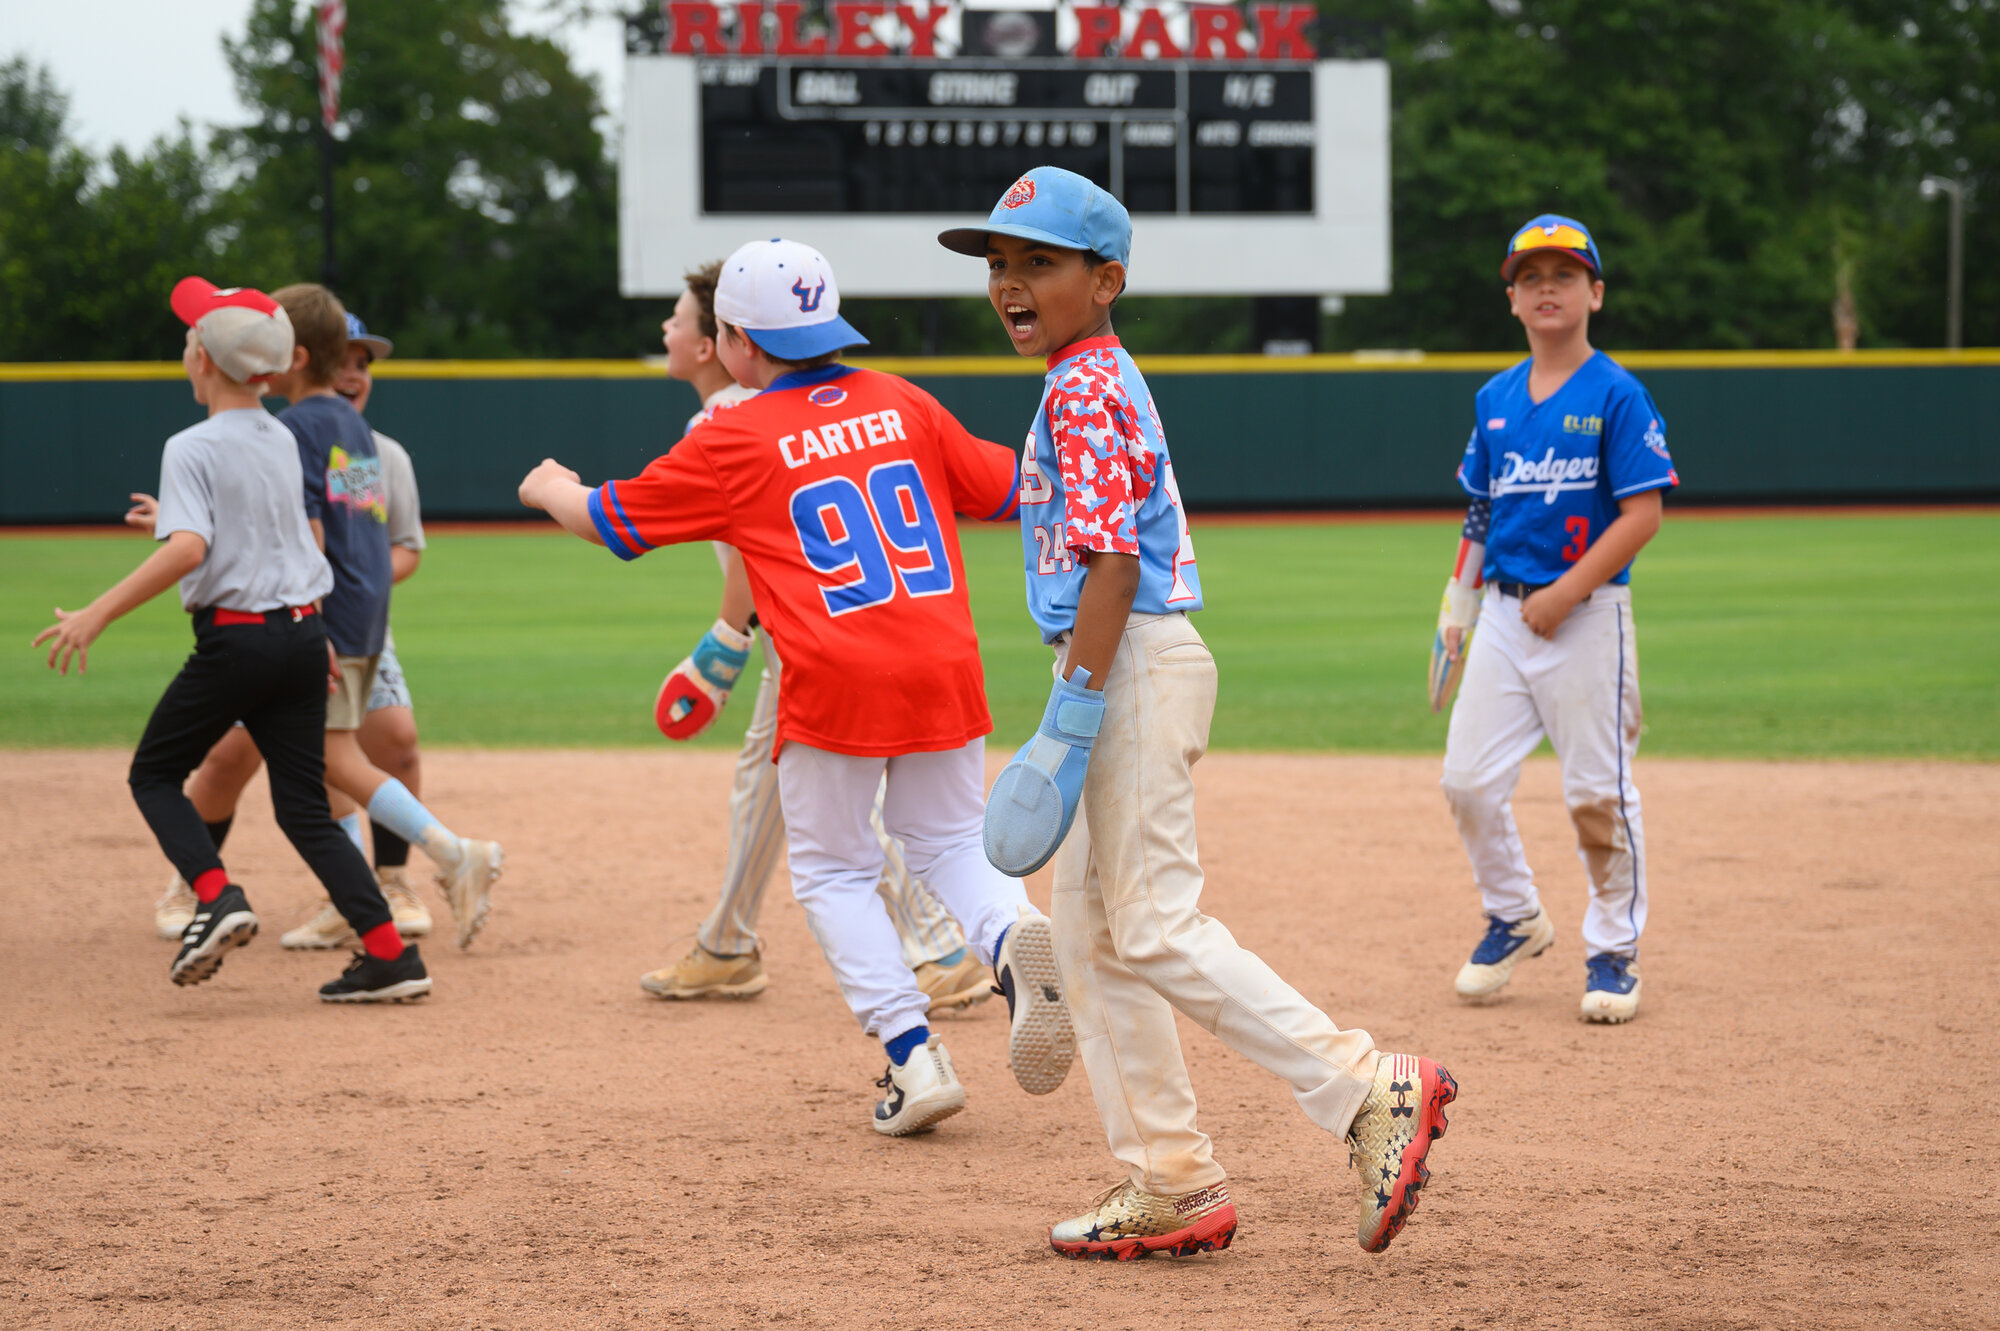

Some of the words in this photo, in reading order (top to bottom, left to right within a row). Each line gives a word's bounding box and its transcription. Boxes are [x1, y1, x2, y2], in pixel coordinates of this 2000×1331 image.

[669, 2, 948, 56] RILEY
[1074, 5, 1318, 59] PARK
[796, 71, 861, 105] BALL
[929, 72, 1018, 105] STRIKE
[1085, 73, 1140, 106] OUT
[778, 408, 907, 469] CARTER
[789, 459, 954, 618] 99
[1034, 522, 1073, 576] 24
[1562, 516, 1589, 562] 3
[1172, 1189, 1209, 1209] UNDER
[1176, 1191, 1220, 1215] ARMOUR
